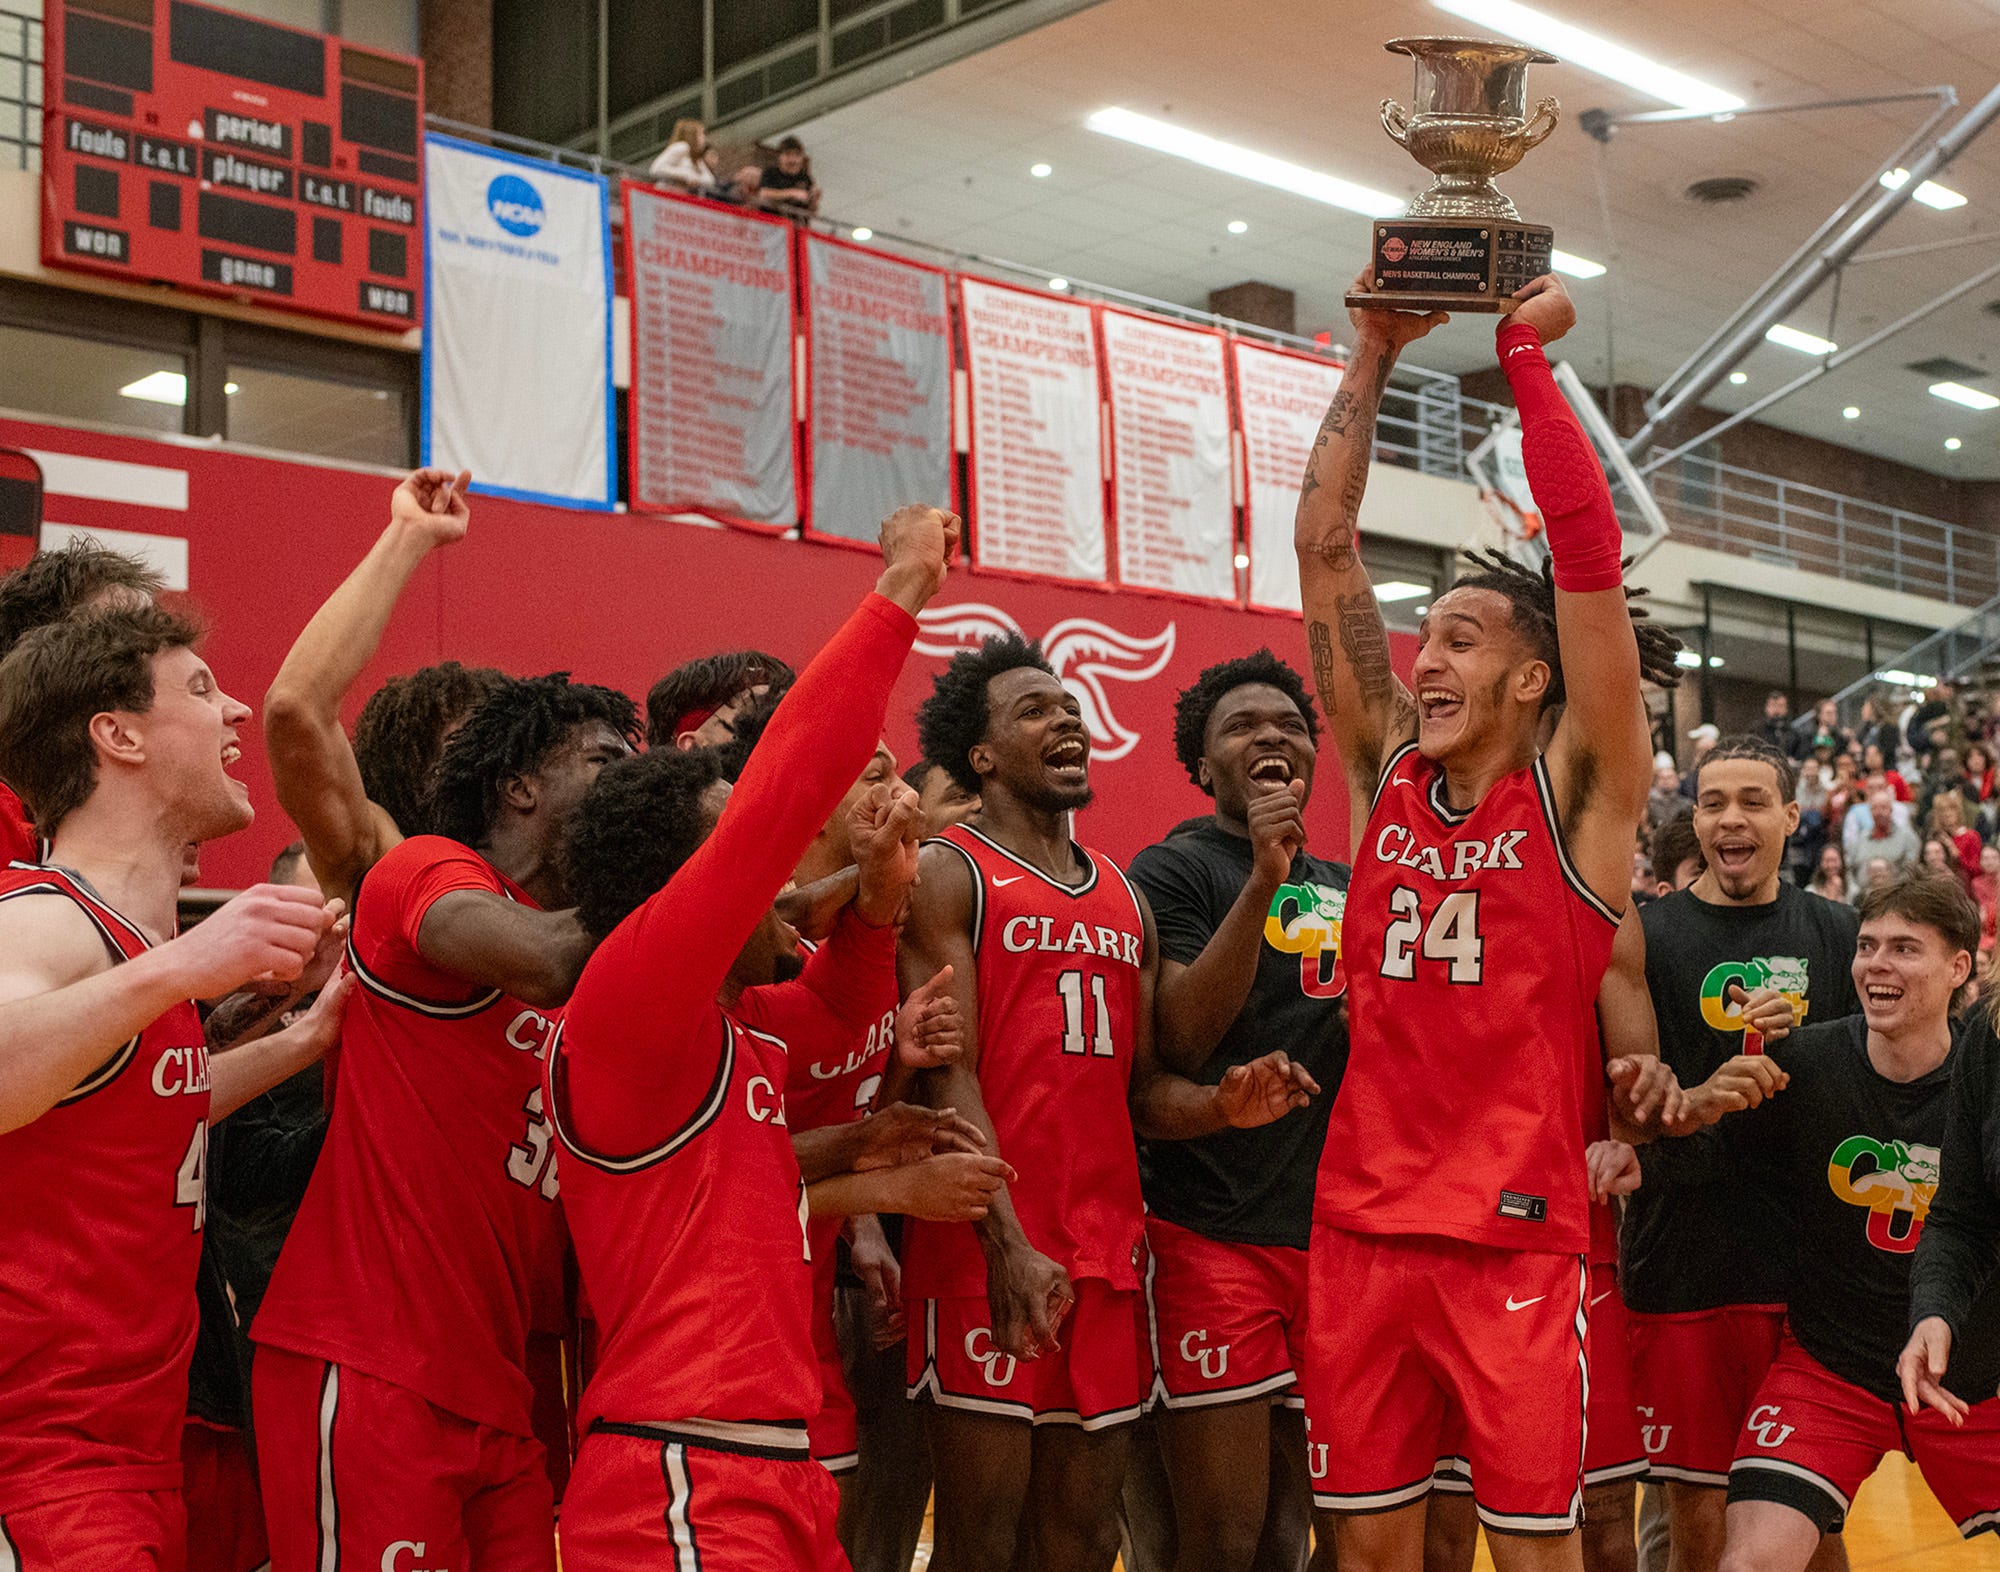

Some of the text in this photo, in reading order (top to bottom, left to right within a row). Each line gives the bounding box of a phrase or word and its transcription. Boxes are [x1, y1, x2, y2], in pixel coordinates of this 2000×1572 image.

[71, 121, 126, 160] fouls
[216, 113, 282, 150] period
[213, 154, 284, 192] player
[364, 188, 413, 224] fouls
[75, 227, 121, 257] won
[1409, 247, 1485, 258] WOMEN'S & MEN'S
[1411, 240, 1473, 250] NEW ENGLAND
[221, 257, 276, 289] game
[638, 239, 786, 294] CHAMPIONS
[1382, 270, 1481, 281] MEN'S BASKETBALL CHAMPIONS
[368, 286, 408, 315] won
[1375, 823, 1529, 881] CLARK
[1002, 915, 1140, 969] CLARK
[1379, 884, 1485, 985] 24
[1056, 970, 1115, 1058] 11
[1534, 1203, 1540, 1215] L
[964, 1326, 1017, 1387] CU
[1179, 1328, 1230, 1380] CU
[1747, 1404, 1796, 1449] CU
